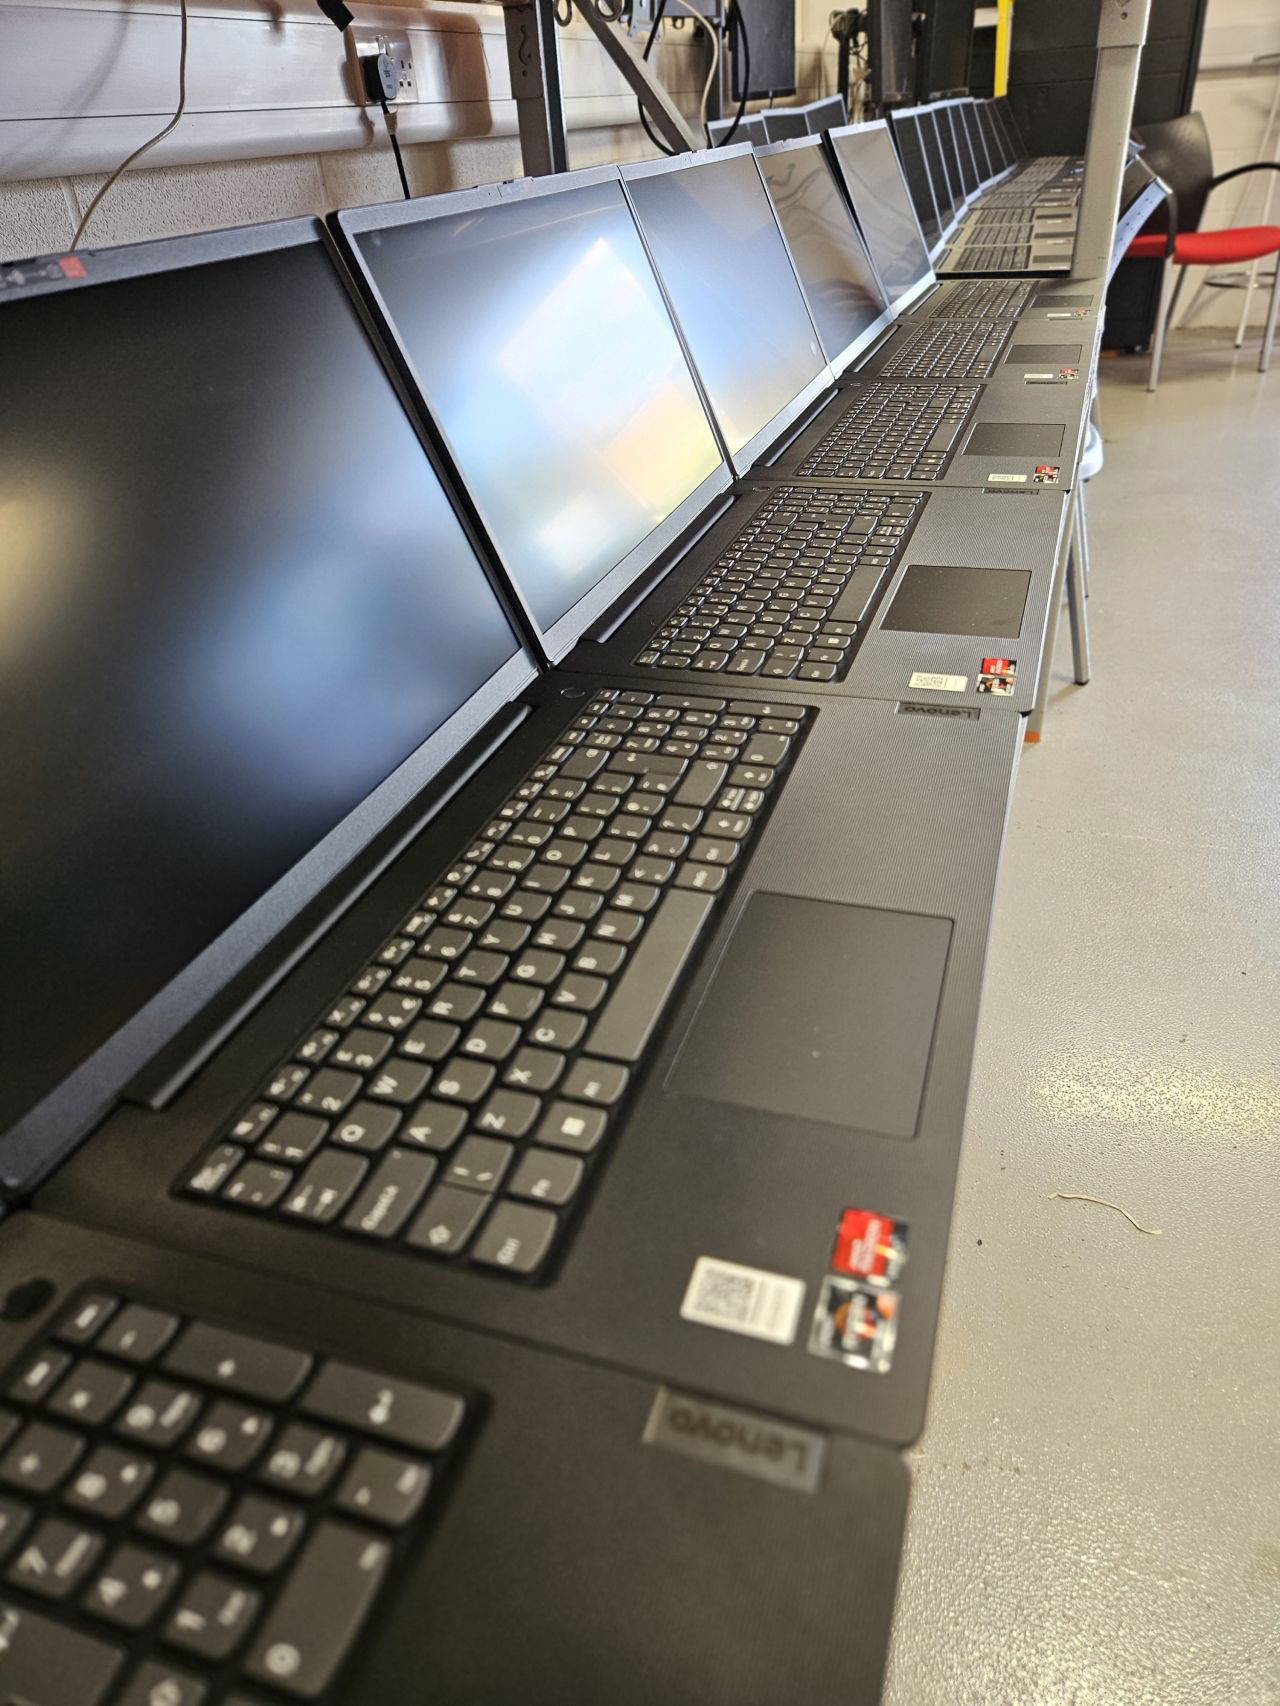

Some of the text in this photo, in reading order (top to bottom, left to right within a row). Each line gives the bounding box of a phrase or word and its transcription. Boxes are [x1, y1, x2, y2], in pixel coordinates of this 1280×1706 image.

[904, 706, 972, 718] Lenovo
[563, 827, 577, 836] P
[546, 850, 562, 860] O
[594, 852, 611, 860] L
[576, 876, 595, 887] K
[505, 904, 523, 915] U
[560, 904, 575, 914] J
[483, 934, 500, 944] Y
[459, 966, 476, 977] T
[516, 965, 536, 978] G
[557, 990, 576, 1002] V
[535, 1028, 555, 1042] C
[466, 1038, 488, 1053] D
[509, 1068, 532, 1083] X
[374, 1075, 398, 1093] W
[482, 1112, 506, 1129] Z
[341, 1125, 365, 1142] Q
[410, 1127, 431, 1142] A
[670, 1409, 806, 1473] Lenovo
